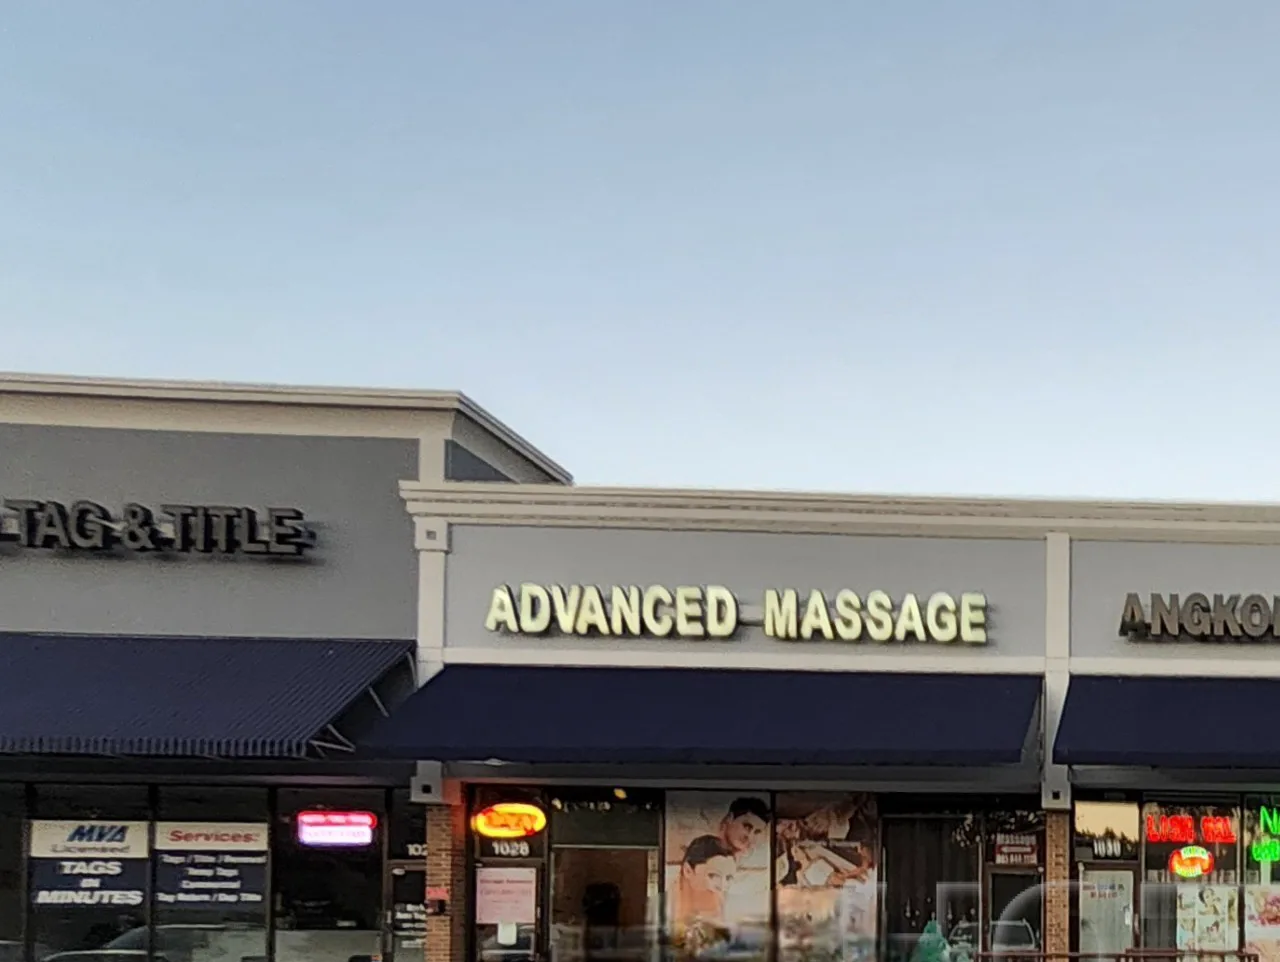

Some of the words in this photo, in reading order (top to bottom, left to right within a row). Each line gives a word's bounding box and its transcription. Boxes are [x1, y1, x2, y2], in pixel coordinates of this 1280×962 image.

[5, 500, 105, 549] TAG
[121, 503, 151, 549] &
[160, 504, 307, 554] TITLE
[484, 583, 738, 637] ADVANCED
[764, 588, 988, 643] MASSAGE
[491, 841, 530, 856] 1028
[59, 861, 123, 876] TAGS
[35, 890, 144, 906] MINUTES
